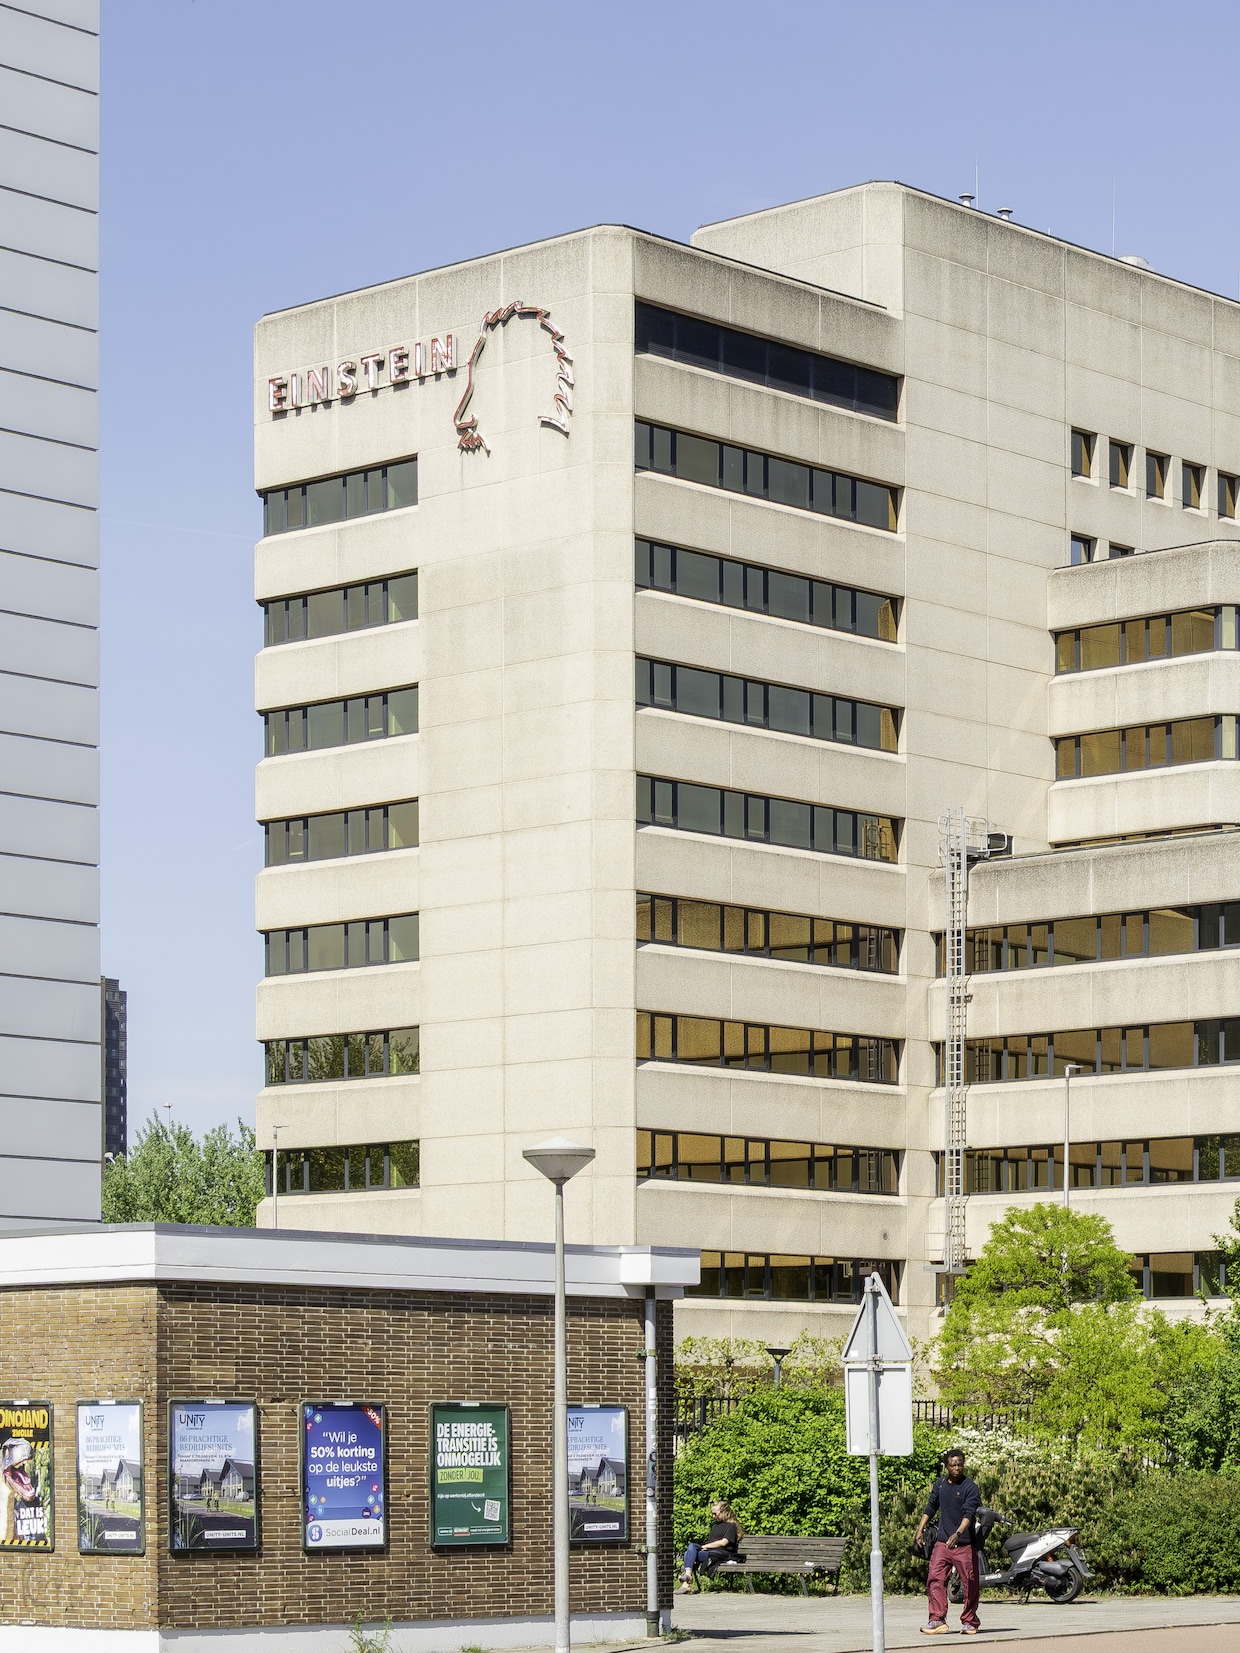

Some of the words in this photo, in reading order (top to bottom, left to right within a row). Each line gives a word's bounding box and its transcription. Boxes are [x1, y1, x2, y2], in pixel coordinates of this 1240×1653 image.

[268, 333, 458, 412] EINSTEIN
[86, 1415, 104, 1428] UNITY
[179, 1414, 206, 1426] UNITY
[568, 1417, 584, 1428] NITY
[437, 1423, 450, 1437] DE
[451, 1423, 496, 1437] ENERGIE-
[348, 1432, 357, 1445] je
[437, 1438, 486, 1452] TRANSITIE
[488, 1437, 498, 1452] IS
[310, 1446, 334, 1458] 50%
[337, 1446, 375, 1459] korting
[437, 1452, 501, 1467] ONMOGELIJK
[308, 1464, 323, 1475] op
[326, 1461, 339, 1472] de
[342, 1460, 378, 1472] leukste
[440, 1471, 464, 1481] ZONDER
[20, 1508, 34, 1518] DAT
[36, 1507, 43, 1518] IS
[16, 1518, 48, 1536] LEUK!
[326, 1526, 380, 1537] SocialDeal.nl
